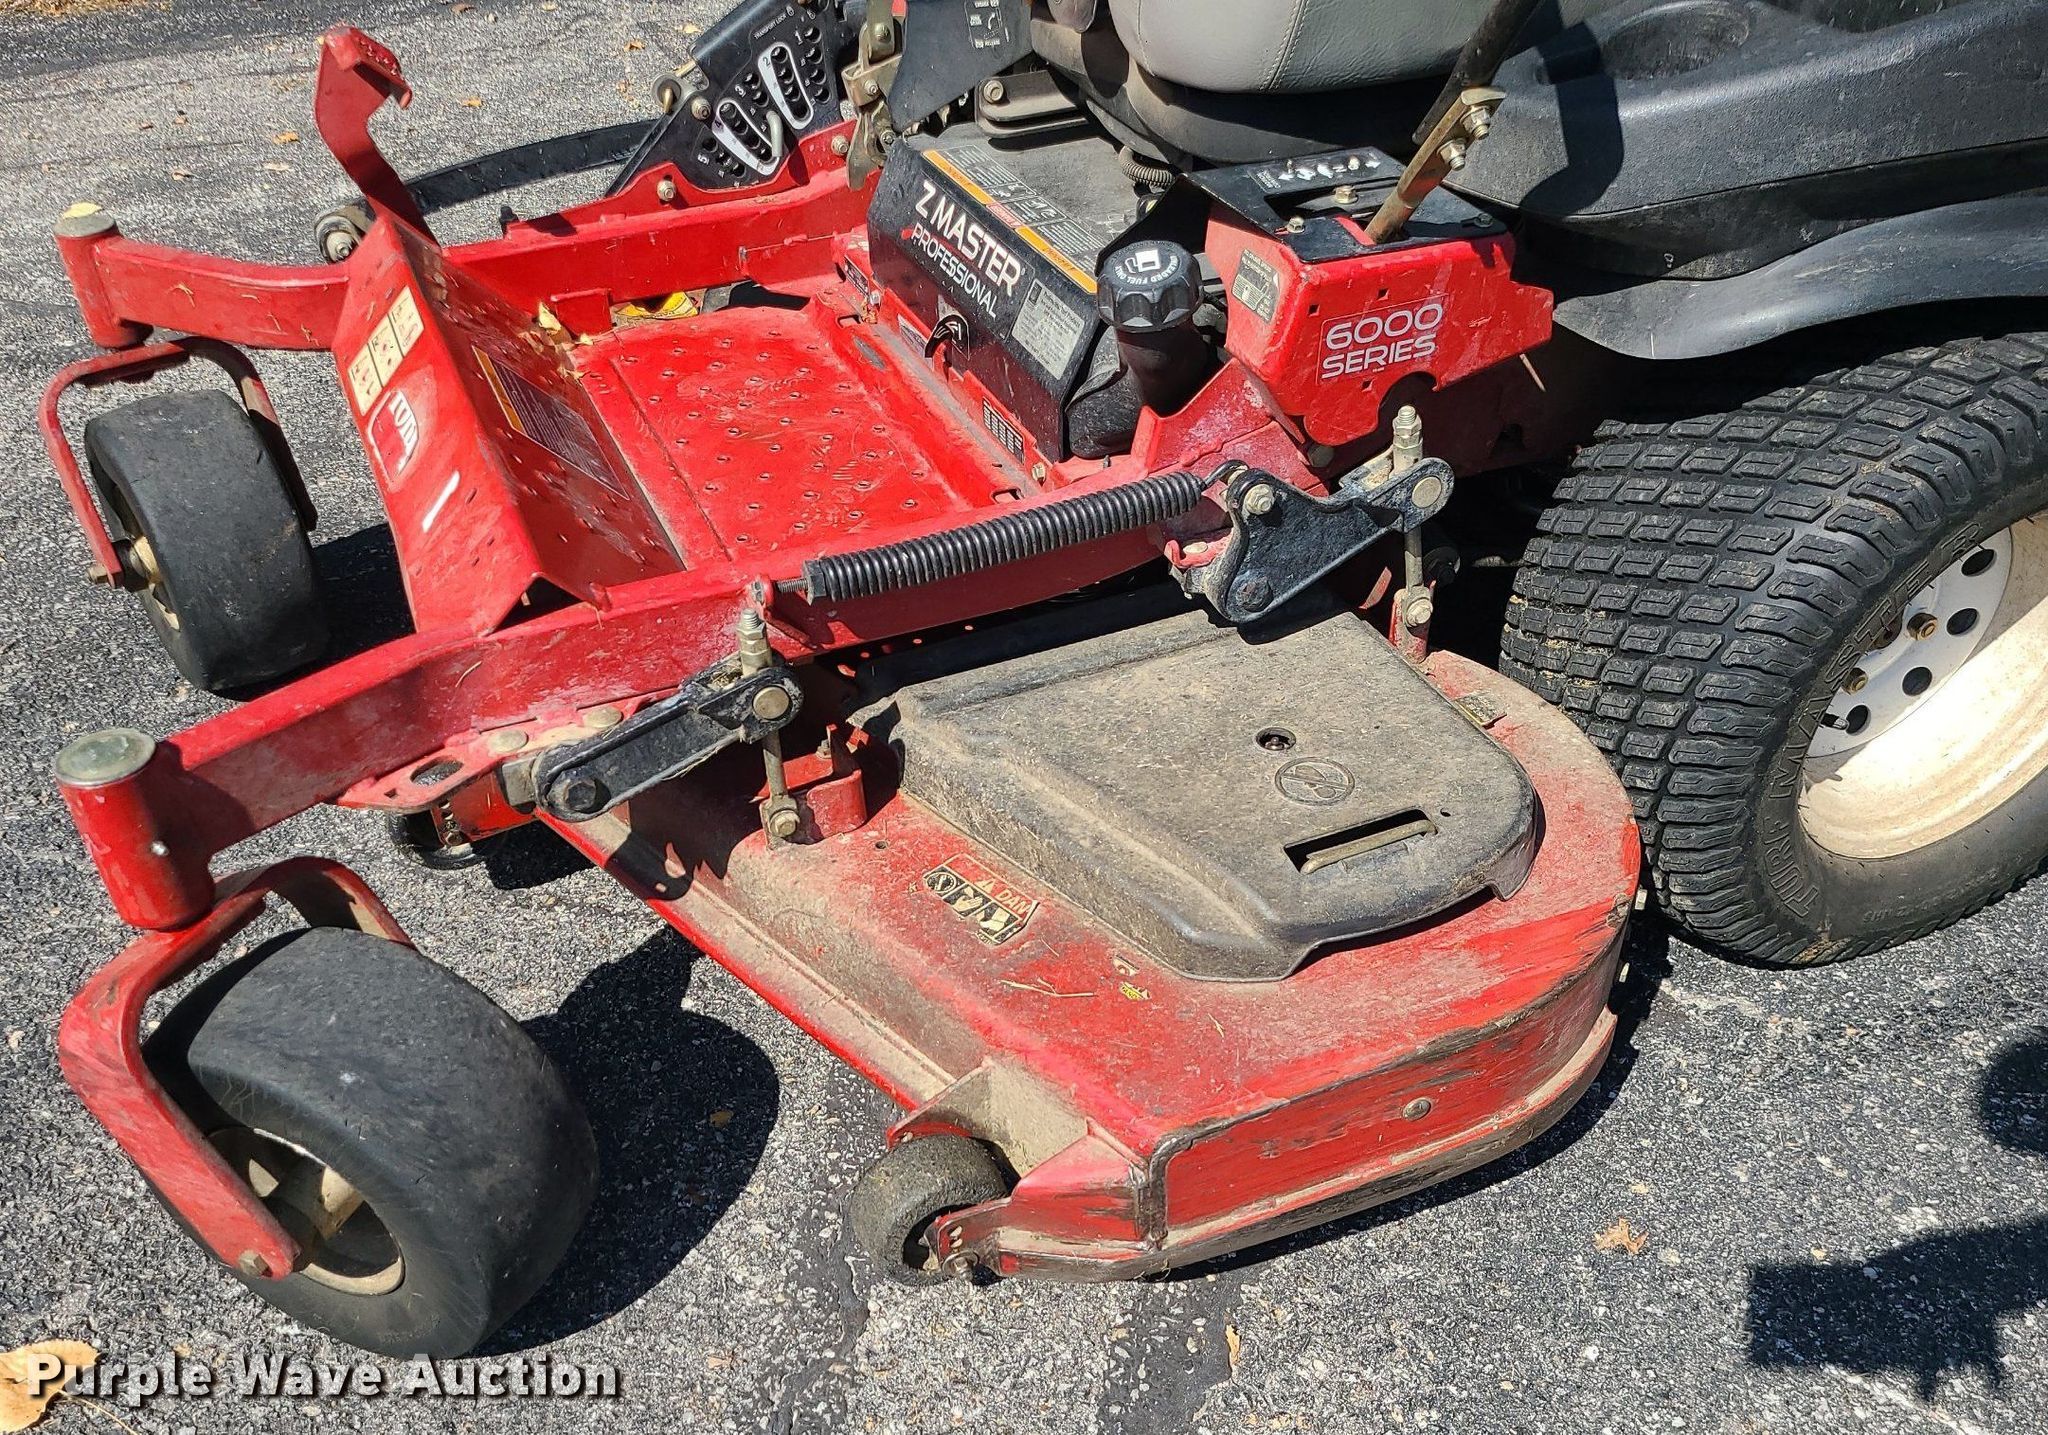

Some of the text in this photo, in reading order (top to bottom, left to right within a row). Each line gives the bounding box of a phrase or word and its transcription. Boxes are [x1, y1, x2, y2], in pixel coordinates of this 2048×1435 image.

[794, 30, 804, 45] 1
[763, 57, 771, 67] 2
[735, 85, 746, 97] 3
[715, 120, 723, 128] 4
[697, 153, 709, 165] 5
[915, 179, 937, 219] Z
[929, 196, 1021, 297] MASTER
[911, 222, 998, 319] PROFESSIONAL
[1126, 276, 1148, 285] FUEL
[1326, 303, 1443, 350] 6000
[1321, 333, 1437, 379] SERIES
[1769, 521, 1983, 799] MASTER
[1763, 815, 1820, 919] TURF
